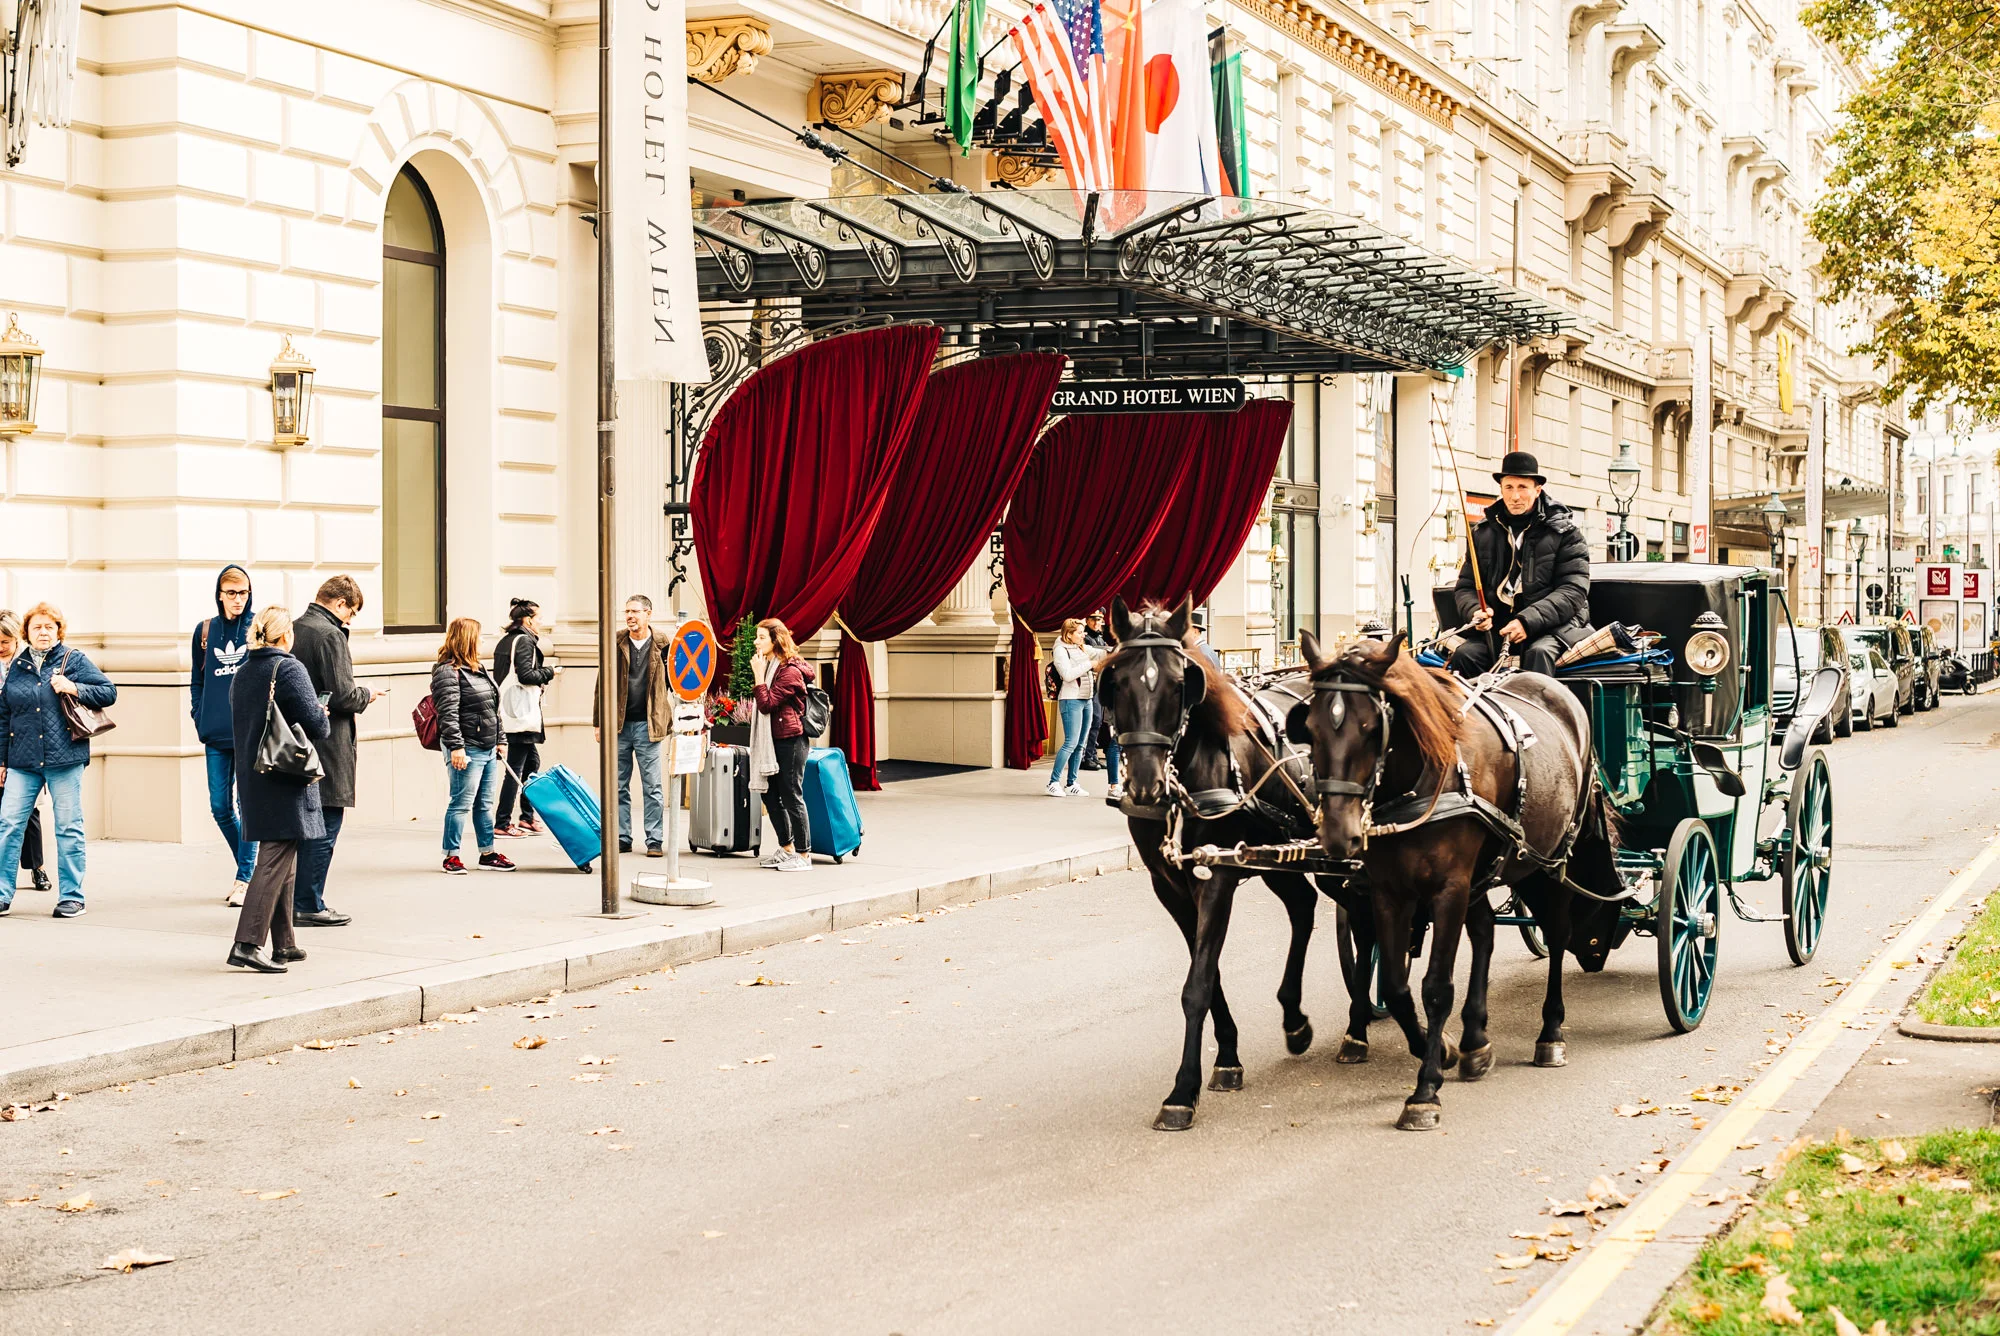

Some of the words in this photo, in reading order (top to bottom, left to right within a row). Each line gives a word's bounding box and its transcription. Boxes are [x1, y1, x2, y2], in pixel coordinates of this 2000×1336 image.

[1051, 391, 1118, 406] GRAND
[1122, 389, 1182, 405] HOTEL
[1187, 387, 1237, 404] WIEN
